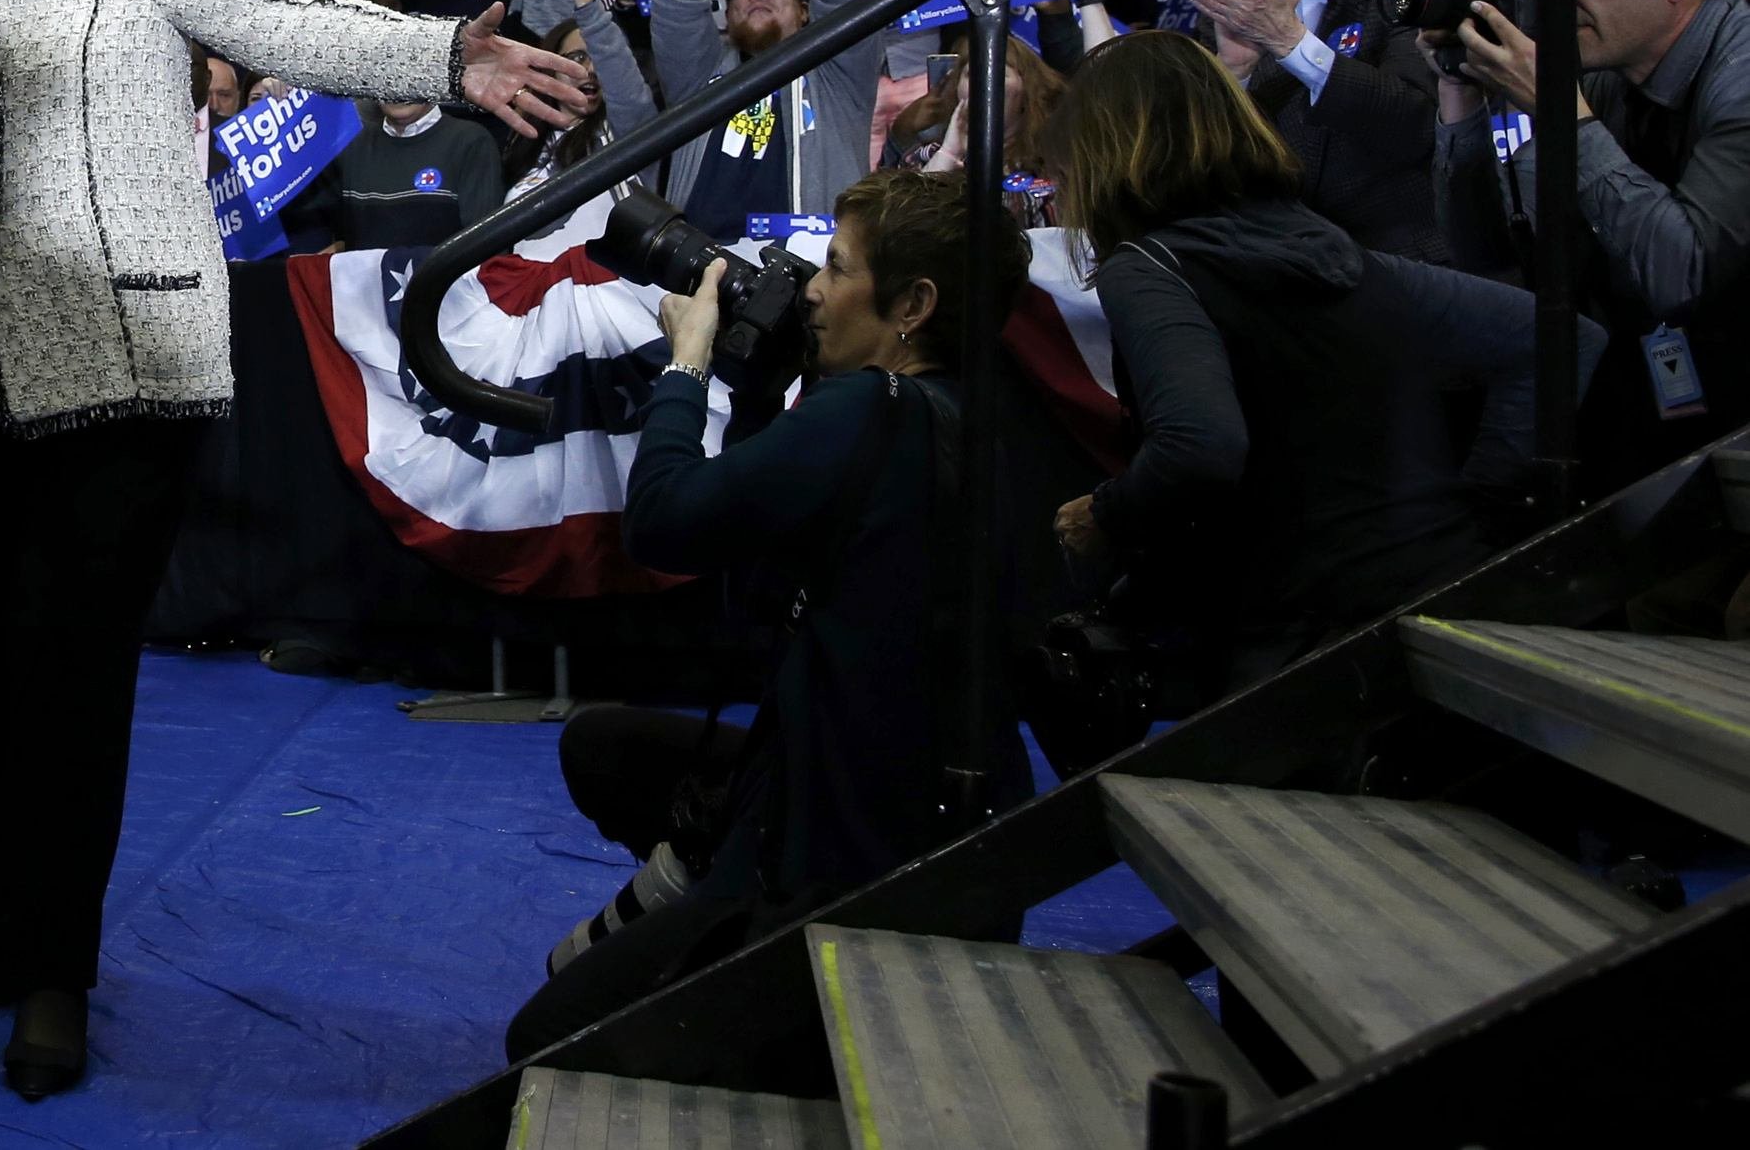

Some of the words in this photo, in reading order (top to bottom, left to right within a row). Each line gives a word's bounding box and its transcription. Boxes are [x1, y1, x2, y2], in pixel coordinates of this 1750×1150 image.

[219, 87, 314, 157] Fight
[236, 141, 284, 189] for
[285, 113, 318, 154] us
[218, 209, 243, 238] us
[1652, 344, 1683, 360] PRESS
[886, 370, 898, 397] SO
